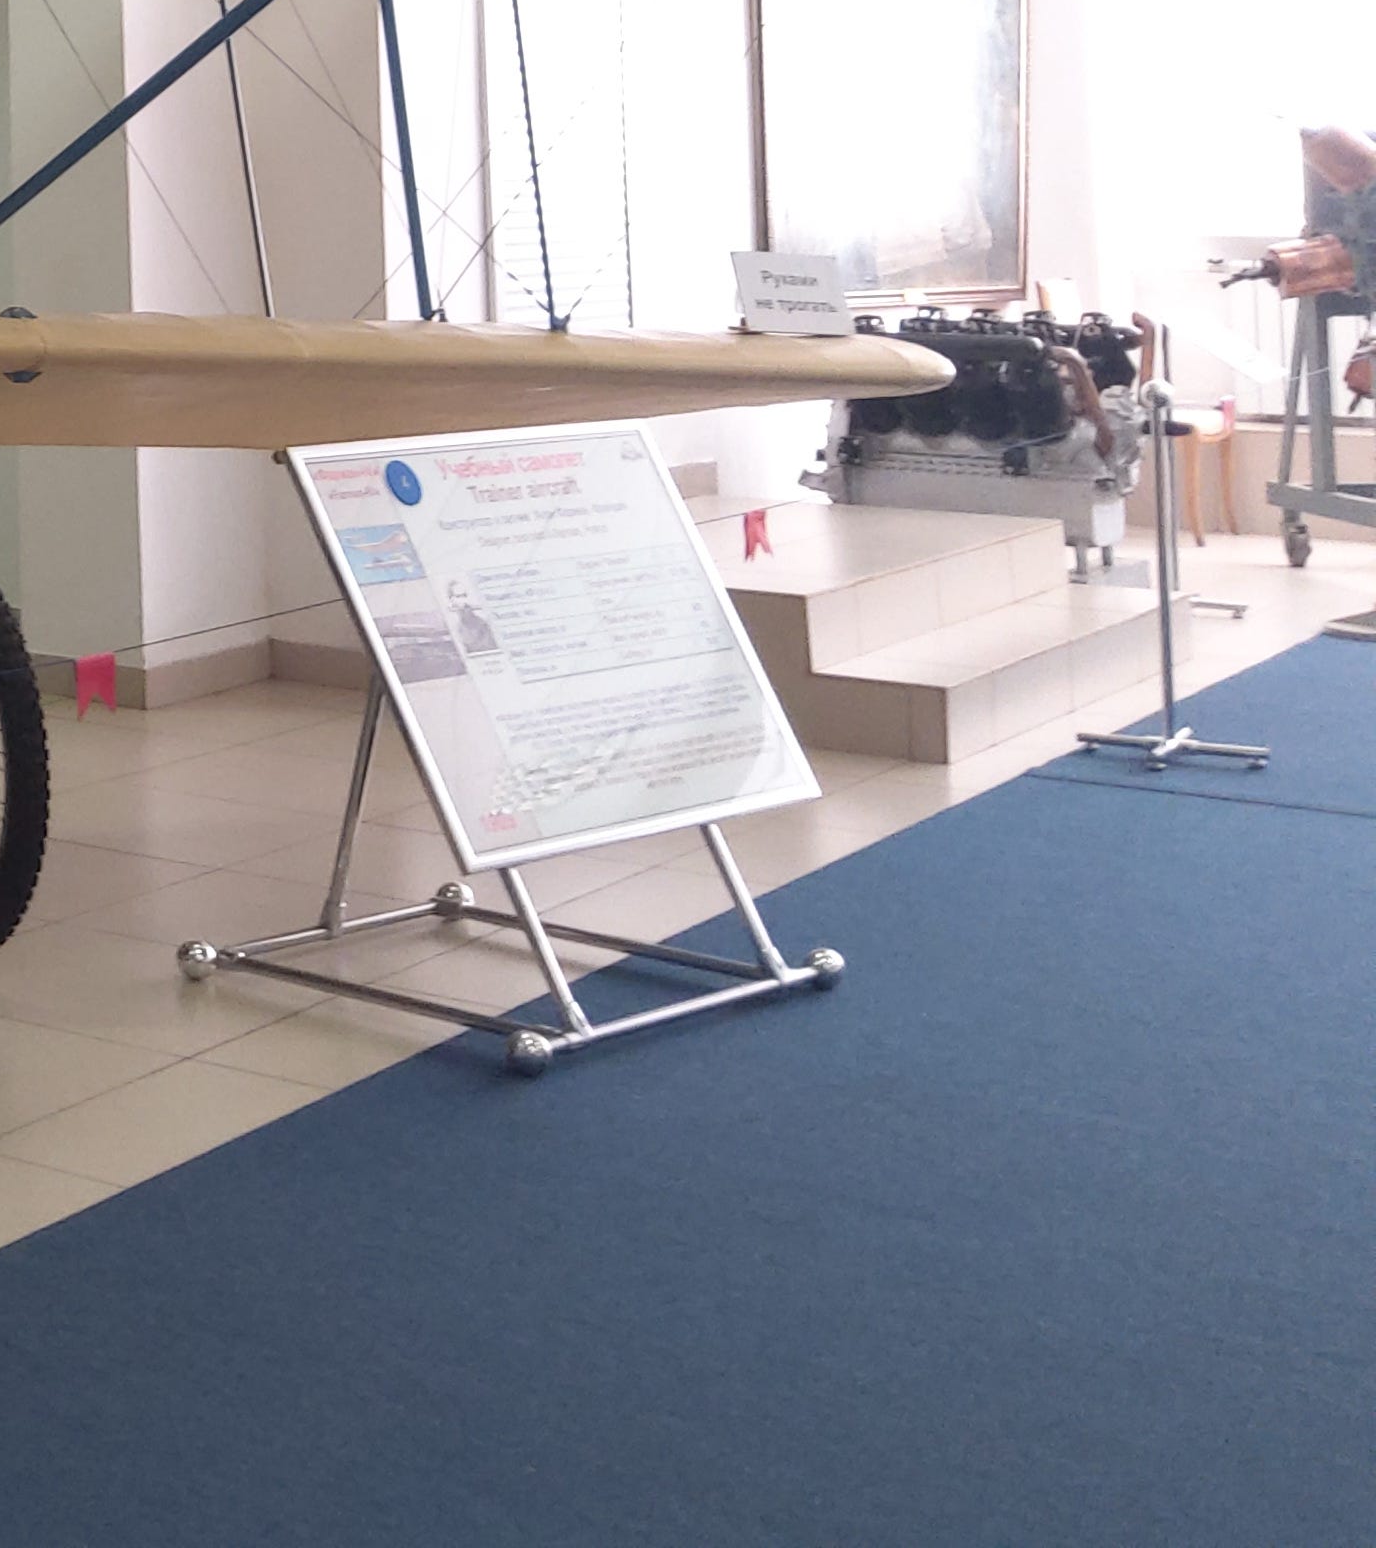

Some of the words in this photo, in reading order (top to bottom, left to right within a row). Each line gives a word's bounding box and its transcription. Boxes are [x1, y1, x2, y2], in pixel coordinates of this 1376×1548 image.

[760, 270, 819, 288] Руками
[755, 299, 774, 310] не
[776, 299, 839, 314] трогать
[465, 484, 528, 504] Trainer
